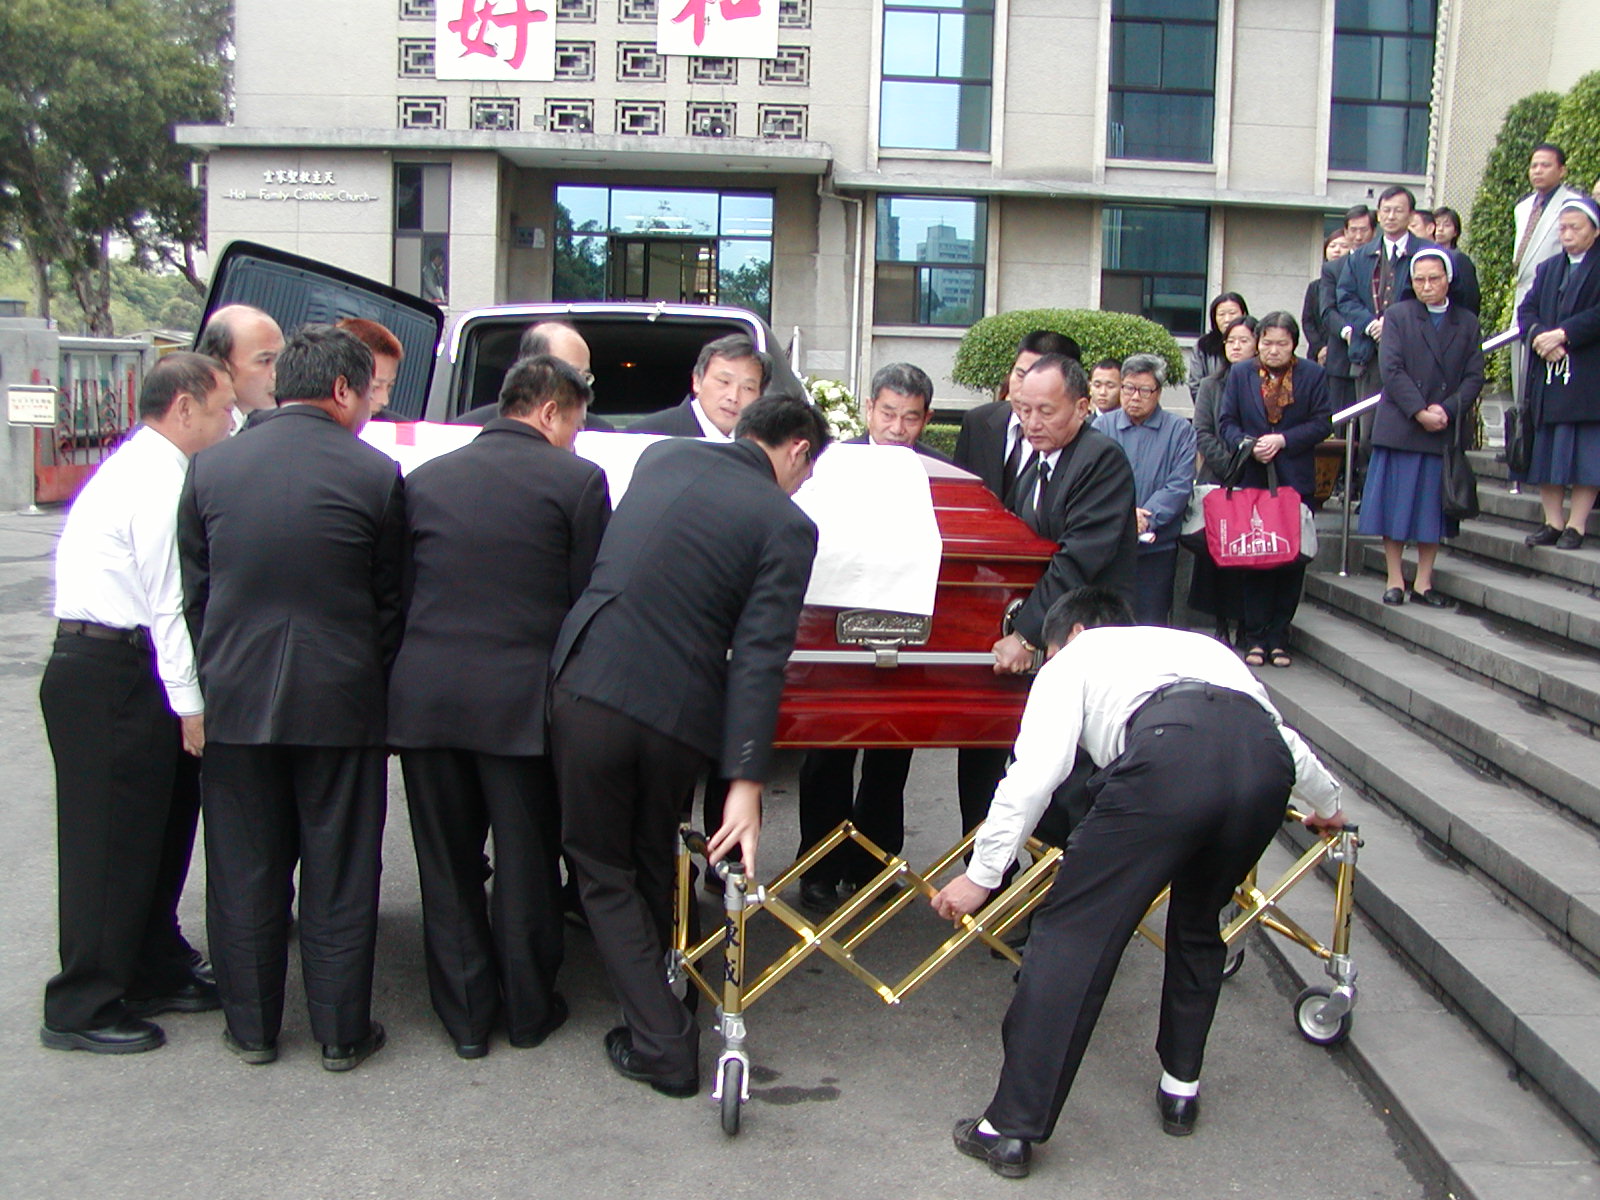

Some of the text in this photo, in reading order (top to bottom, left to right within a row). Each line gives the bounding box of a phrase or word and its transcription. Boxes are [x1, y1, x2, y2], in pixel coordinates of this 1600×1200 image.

[448, 0, 548, 70] 好
[294, 187, 334, 201] Catholic
[337, 190, 371, 202] Church
